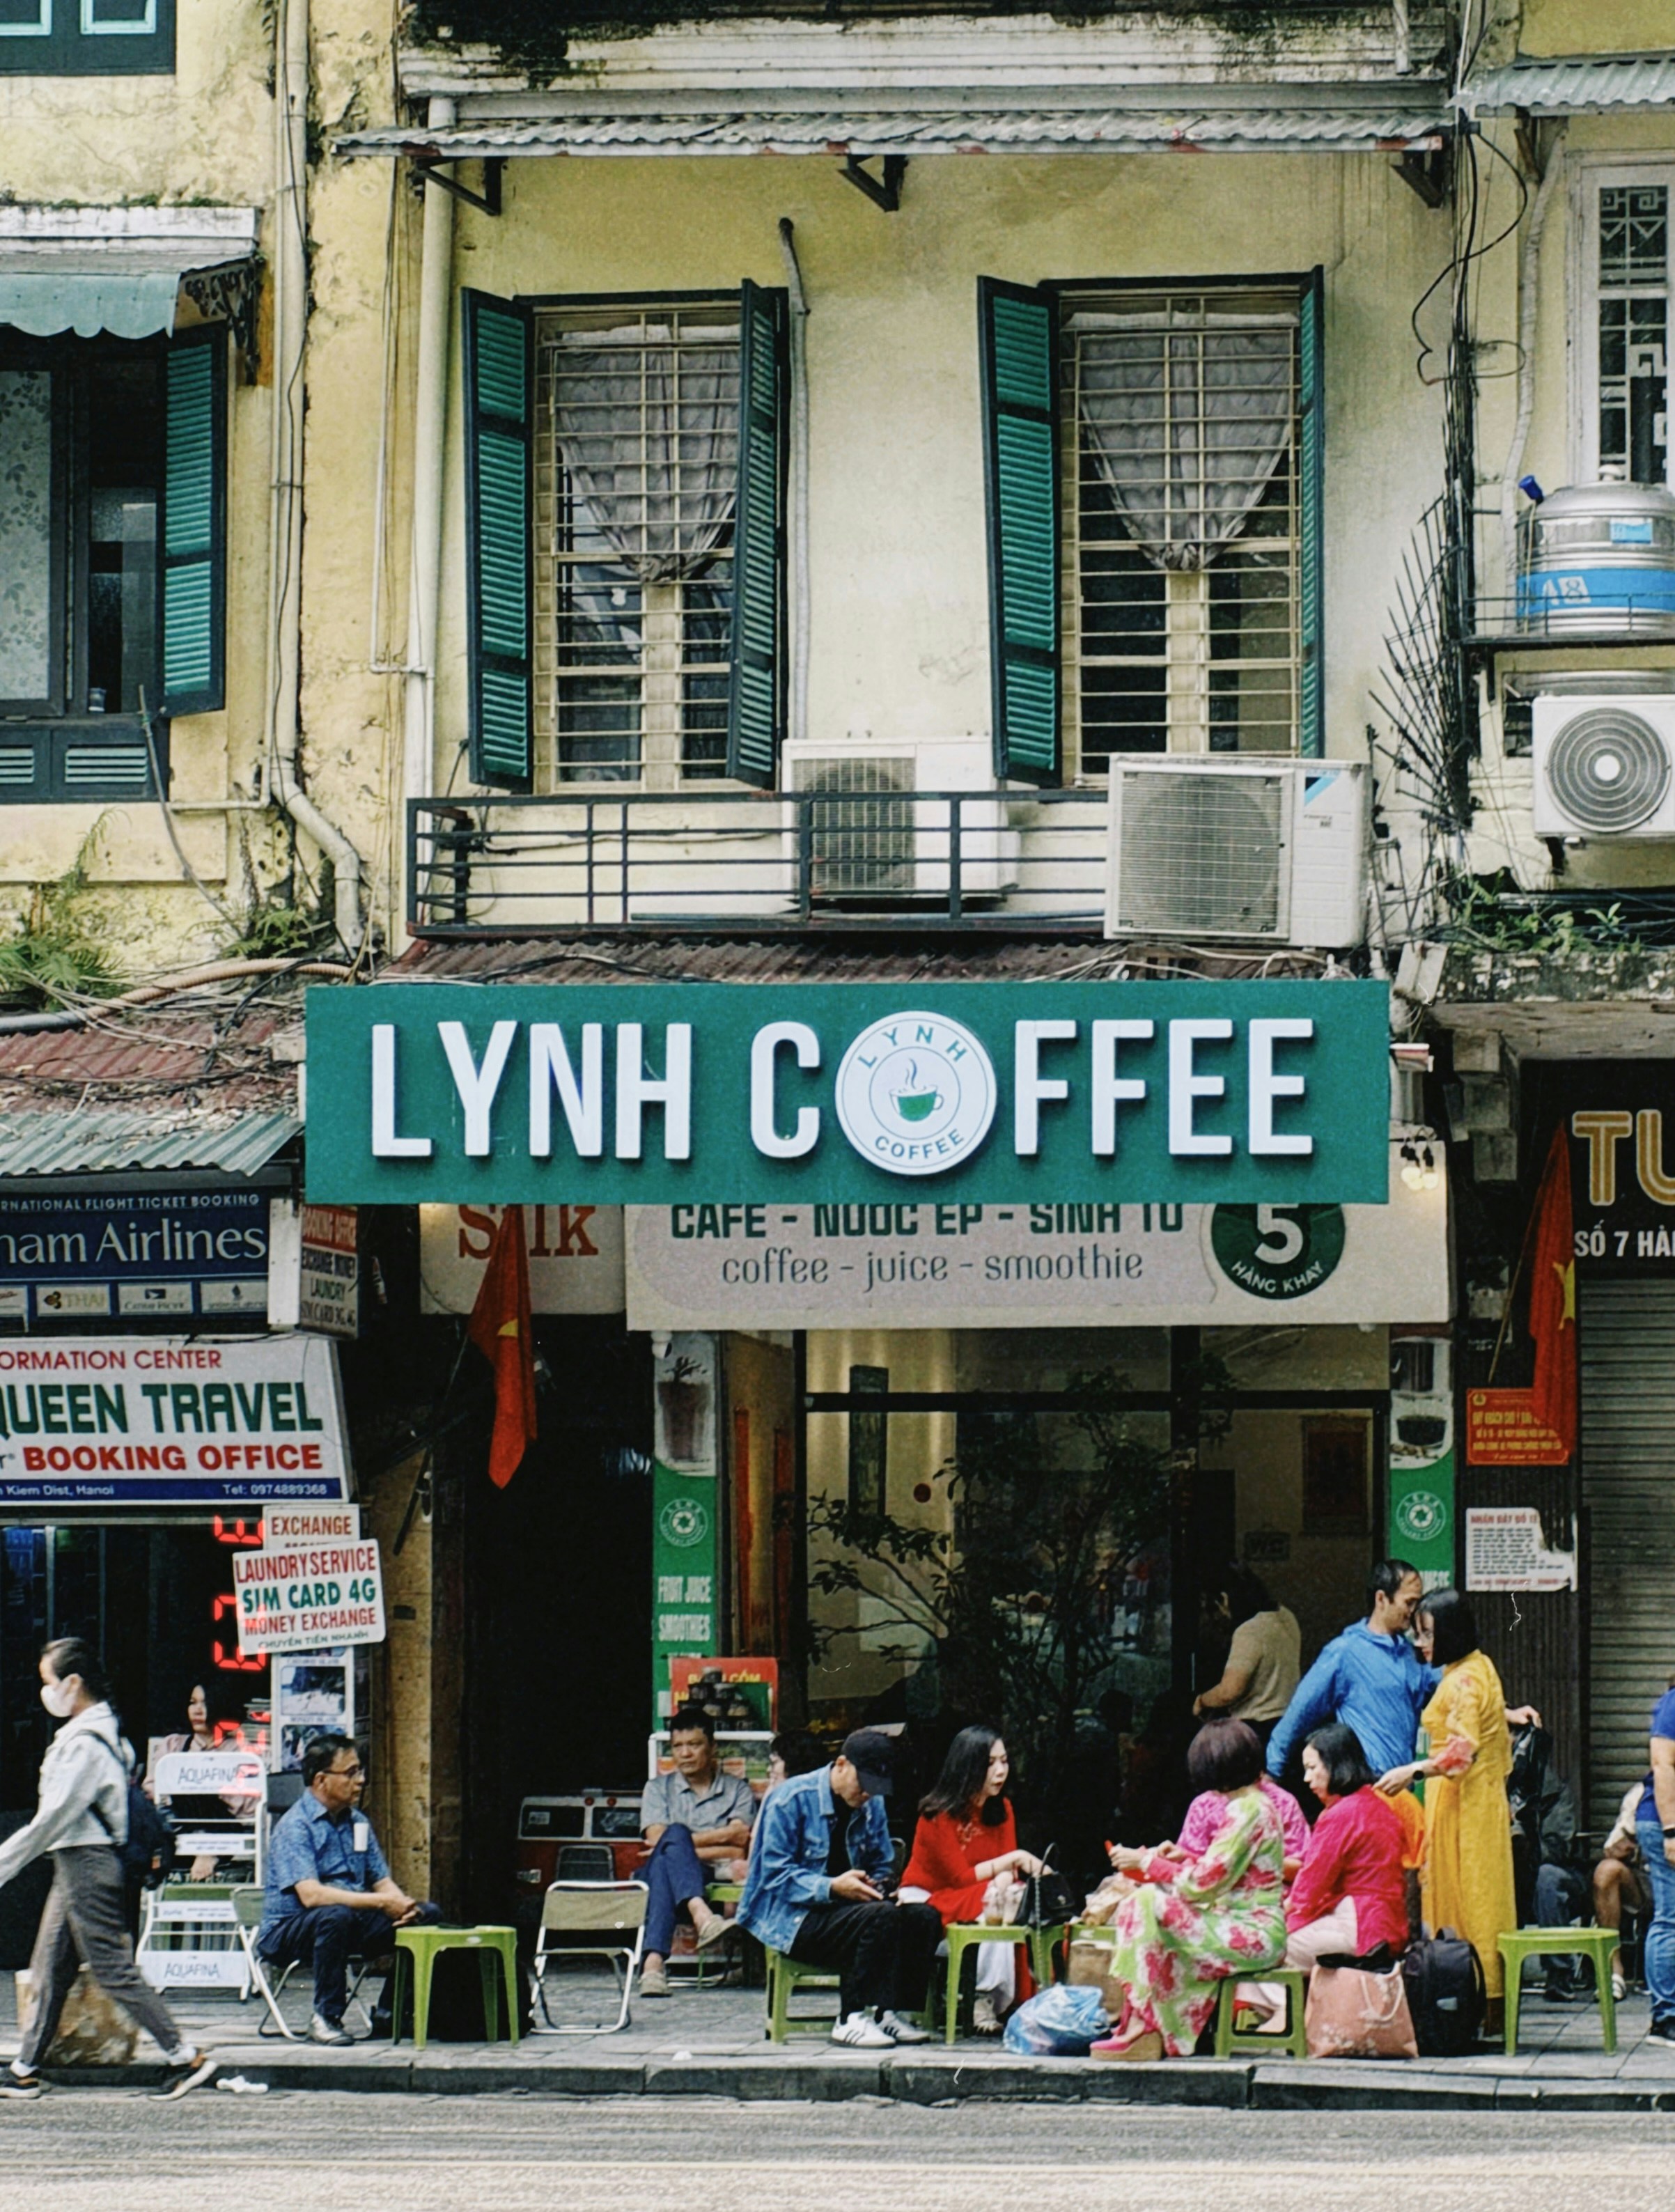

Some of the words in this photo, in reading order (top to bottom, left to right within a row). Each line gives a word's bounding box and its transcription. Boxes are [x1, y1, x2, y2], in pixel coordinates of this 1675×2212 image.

[857, 1025, 967, 1069] LYNH
[372, 1020, 692, 1160] LYNH
[875, 1128, 965, 1160] COFFEE
[84, 1197, 134, 1210] FLIGHT
[139, 1196, 186, 1209] TICKET
[191, 1193, 260, 1207] BOOKING
[671, 1204, 767, 1239] CAFE
[1254, 1203, 1304, 1264] 5
[1574, 1220, 1606, 1257] SỐ
[1614, 1231, 1630, 1257] 7
[95, 1217, 267, 1262] Airlines
[722, 1247, 829, 1284] coffee
[863, 1251, 949, 1293] juice
[984, 1243, 1144, 1281] smoothie
[1282, 1260, 1324, 1293] KHAY
[134, 1350, 221, 1369] CENTER
[141, 1382, 323, 1433] TRAVEL
[23, 1444, 187, 1471] BOOKING
[197, 1444, 323, 1471] OFFICE
[6, 1484, 40, 1495] Kiem
[75, 1484, 114, 1495] Hanoi
[271, 1516, 352, 1536] EXCHANGE
[235, 1552, 307, 1584] LAUNDRY
[310, 1547, 376, 1576] SERVICE
[243, 1587, 281, 1613] SIM
[288, 1581, 341, 1609] CARD
[349, 1578, 376, 1604] 4G
[244, 1614, 296, 1637] MONEY
[301, 1607, 377, 1631] EXCHANGE
[331, 1630, 369, 1642] NHANH
[164, 1962, 220, 1979] AQUAFINA
